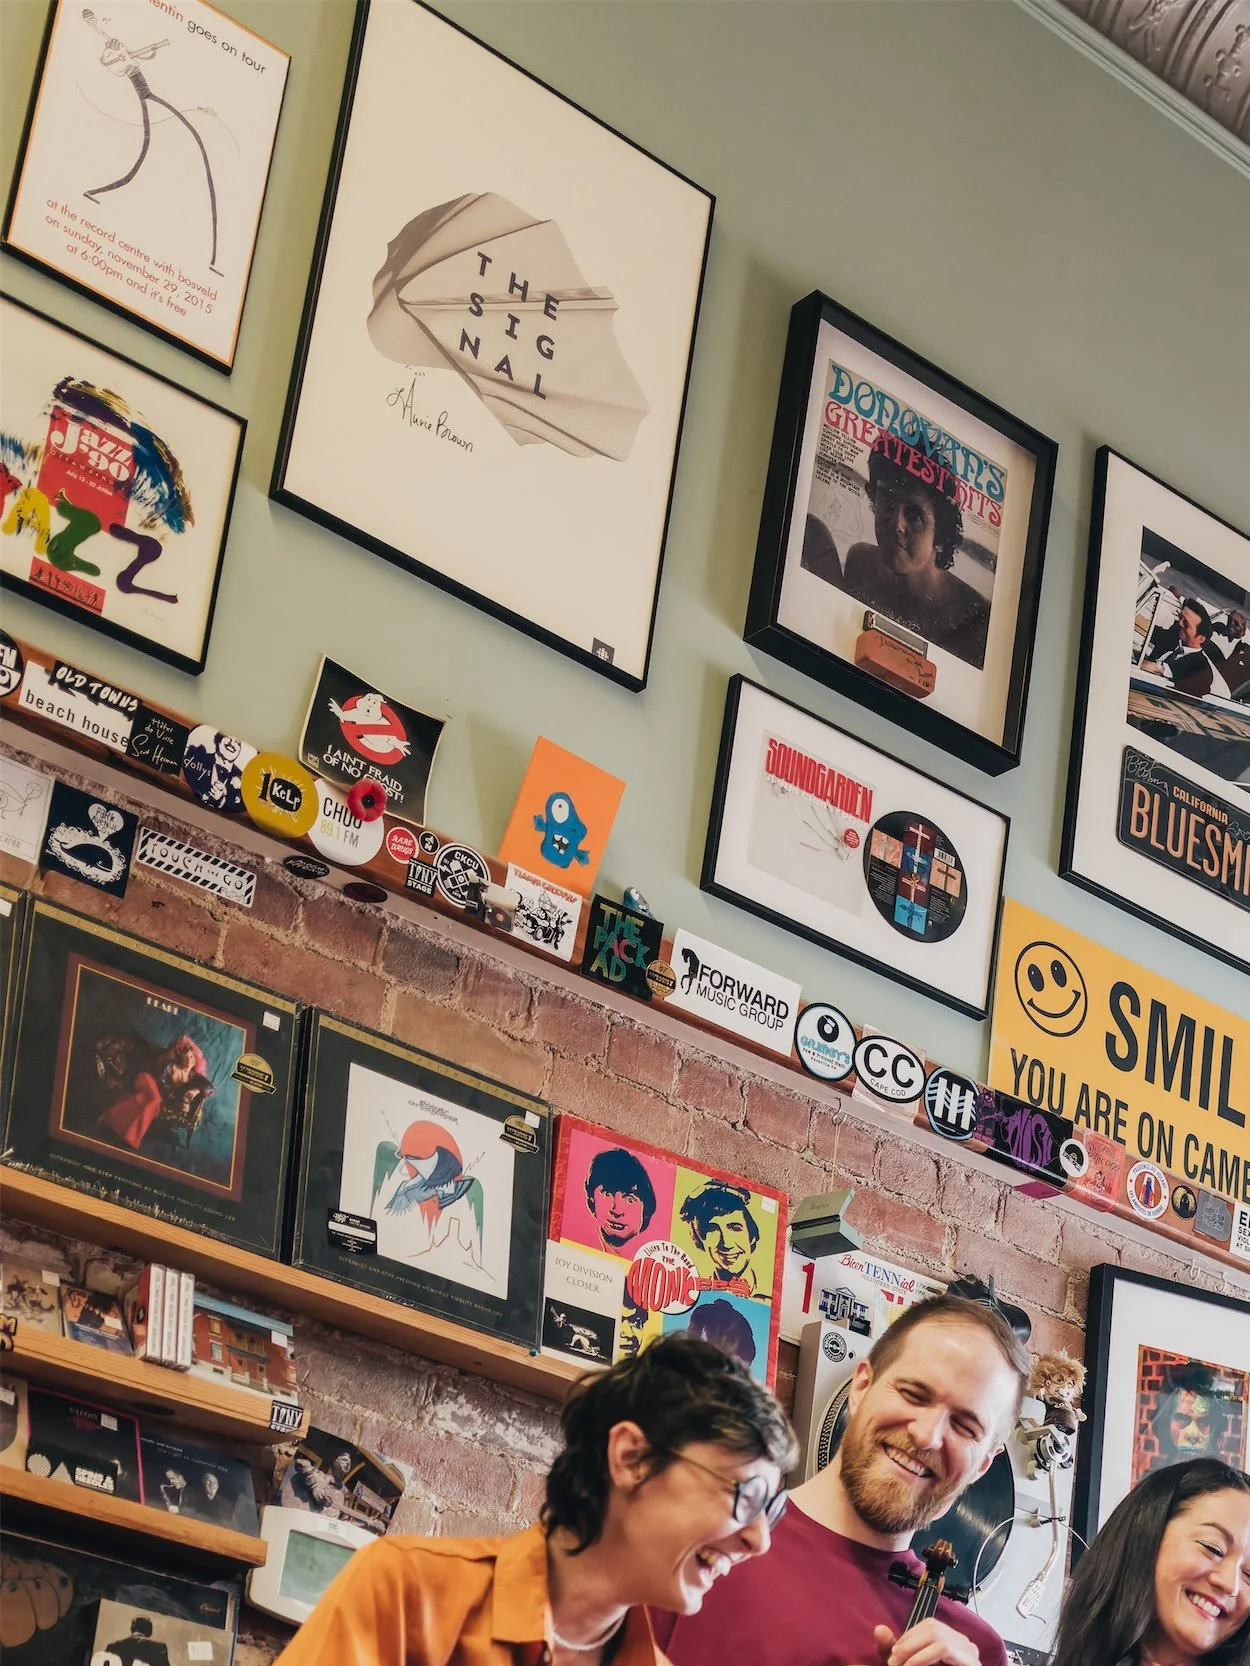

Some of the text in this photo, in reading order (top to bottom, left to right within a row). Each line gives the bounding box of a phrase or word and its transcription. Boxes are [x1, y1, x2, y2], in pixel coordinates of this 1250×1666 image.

[187, 19, 218, 46] goes
[221, 40, 238, 55] on
[241, 47, 267, 75] tour
[45, 215, 213, 315] on sunday, november 29, 2015
[46, 198, 217, 302] at the record centre with bosveld
[66, 243, 187, 317] at 6:00pm and it's free
[477, 251, 561, 321] THE
[50, 418, 133, 467] Jazz
[828, 365, 1008, 502] DONOVAN'S
[825, 401, 951, 492] GREATEST
[954, 483, 1002, 528] HITS
[55, 665, 88, 689] OLD
[25, 688, 129, 749] beach house
[322, 753, 339, 767] OF
[341, 763, 361, 779] NO
[362, 774, 404, 804] OST!
[367, 765, 402, 793] FRAID
[765, 738, 873, 825] SOUNDGARDEN
[1172, 784, 1229, 826] CALIFORNIA
[343, 830, 360, 849] FM
[454, 851, 479, 871] CKCU
[152, 843, 203, 873] TOUCH
[222, 873, 244, 890] GO
[406, 879, 432, 895] STAGE
[600, 902, 645, 942] THE
[590, 956, 626, 983] AD
[699, 964, 789, 1020] FORWARD
[696, 983, 784, 1032] MUSIC GROUP
[864, 1043, 916, 1088] CC
[870, 1077, 907, 1098] CAPE COD
[1010, 1047, 1067, 1115] YOU
[1074, 1082, 1129, 1147] ARE
[1138, 1111, 1174, 1169] ON
[661, 1255, 675, 1267] THE
[670, 1246, 681, 1258] The
[680, 1252, 694, 1270] Band
[1235, 1241, 1243, 1250] AT
[555, 1256, 614, 1285] JOY DIVISION
[566, 1275, 601, 1294] CLOSER
[802, 1261, 816, 1315] 1
